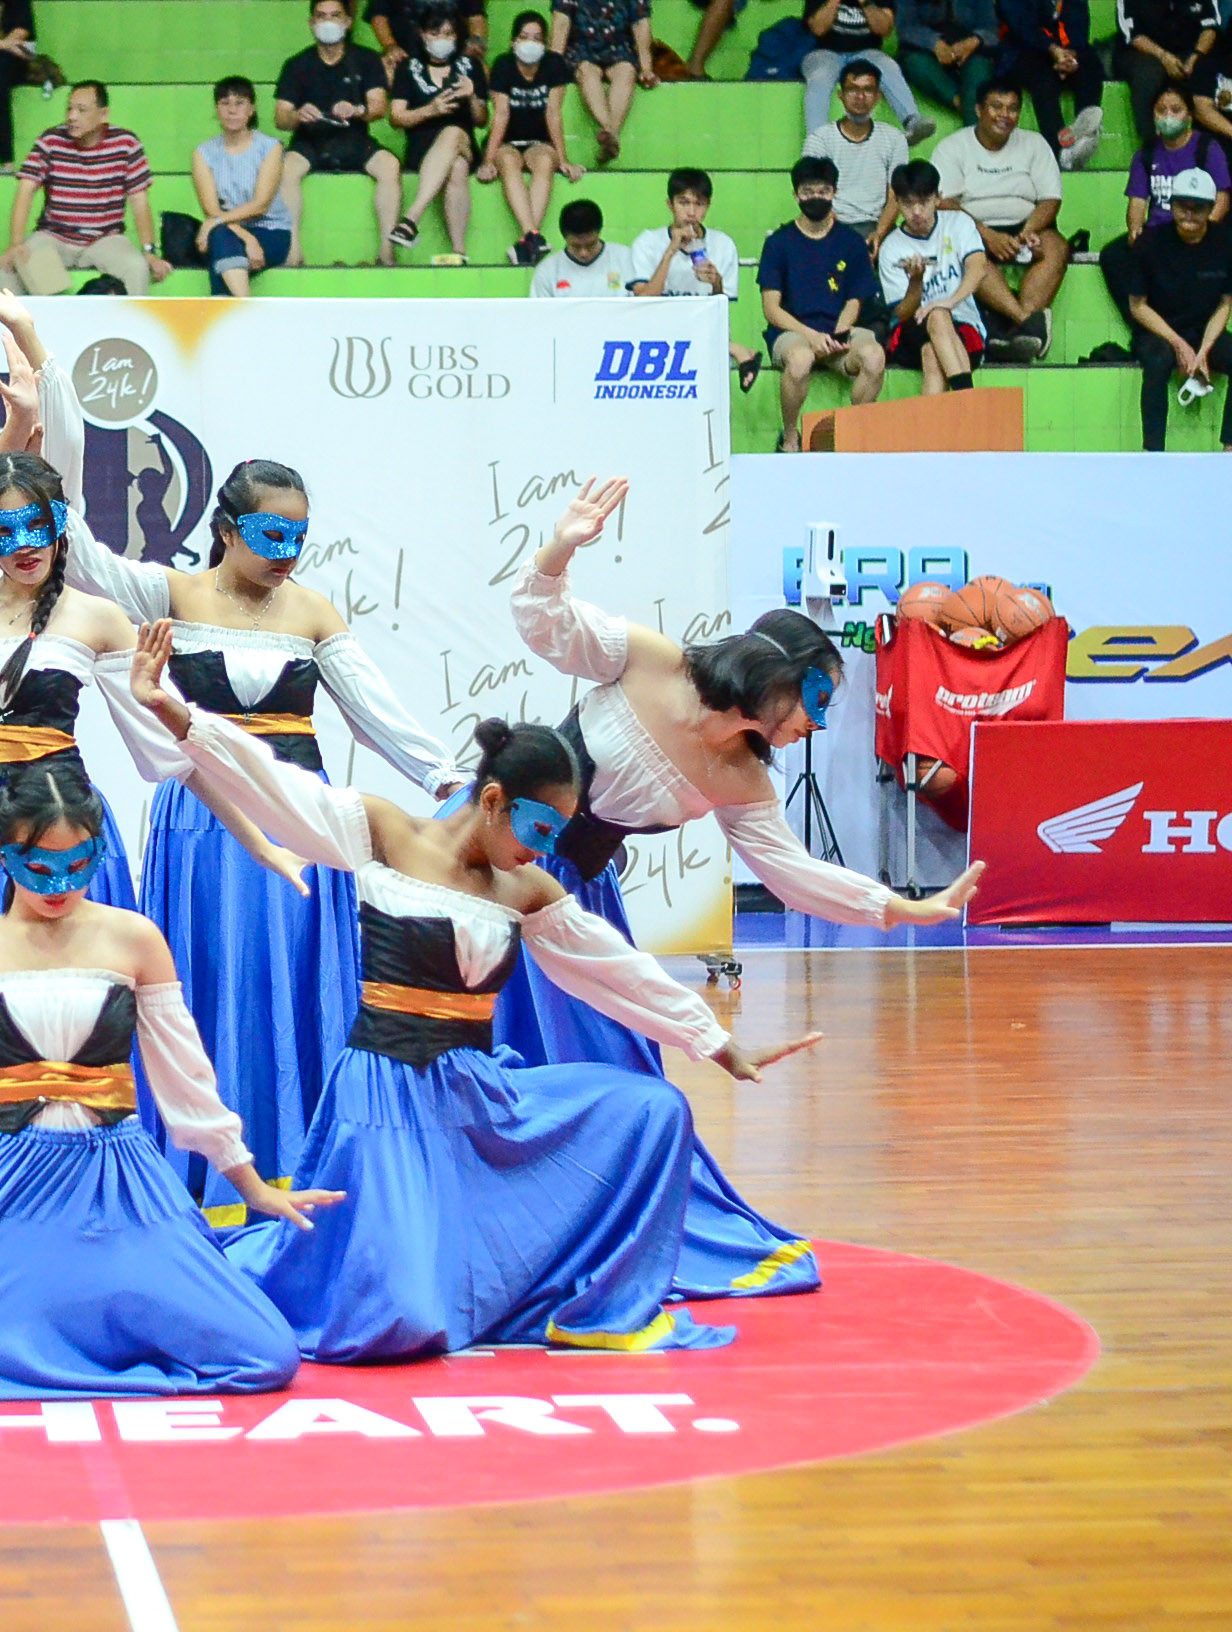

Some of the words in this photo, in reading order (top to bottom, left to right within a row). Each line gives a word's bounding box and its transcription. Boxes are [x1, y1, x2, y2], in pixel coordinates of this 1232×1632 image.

[88, 347, 101, 376] I
[102, 357, 134, 372] am
[408, 345, 480, 371] UBS
[594, 340, 699, 382] DBL
[407, 373, 511, 400] GOLD
[594, 384, 699, 399] INDONESIA
[488, 460, 510, 526] I
[516, 469, 582, 508] am
[440, 649, 462, 715] I
[468, 658, 534, 697] am
[1141, 810, 1232, 853] H
